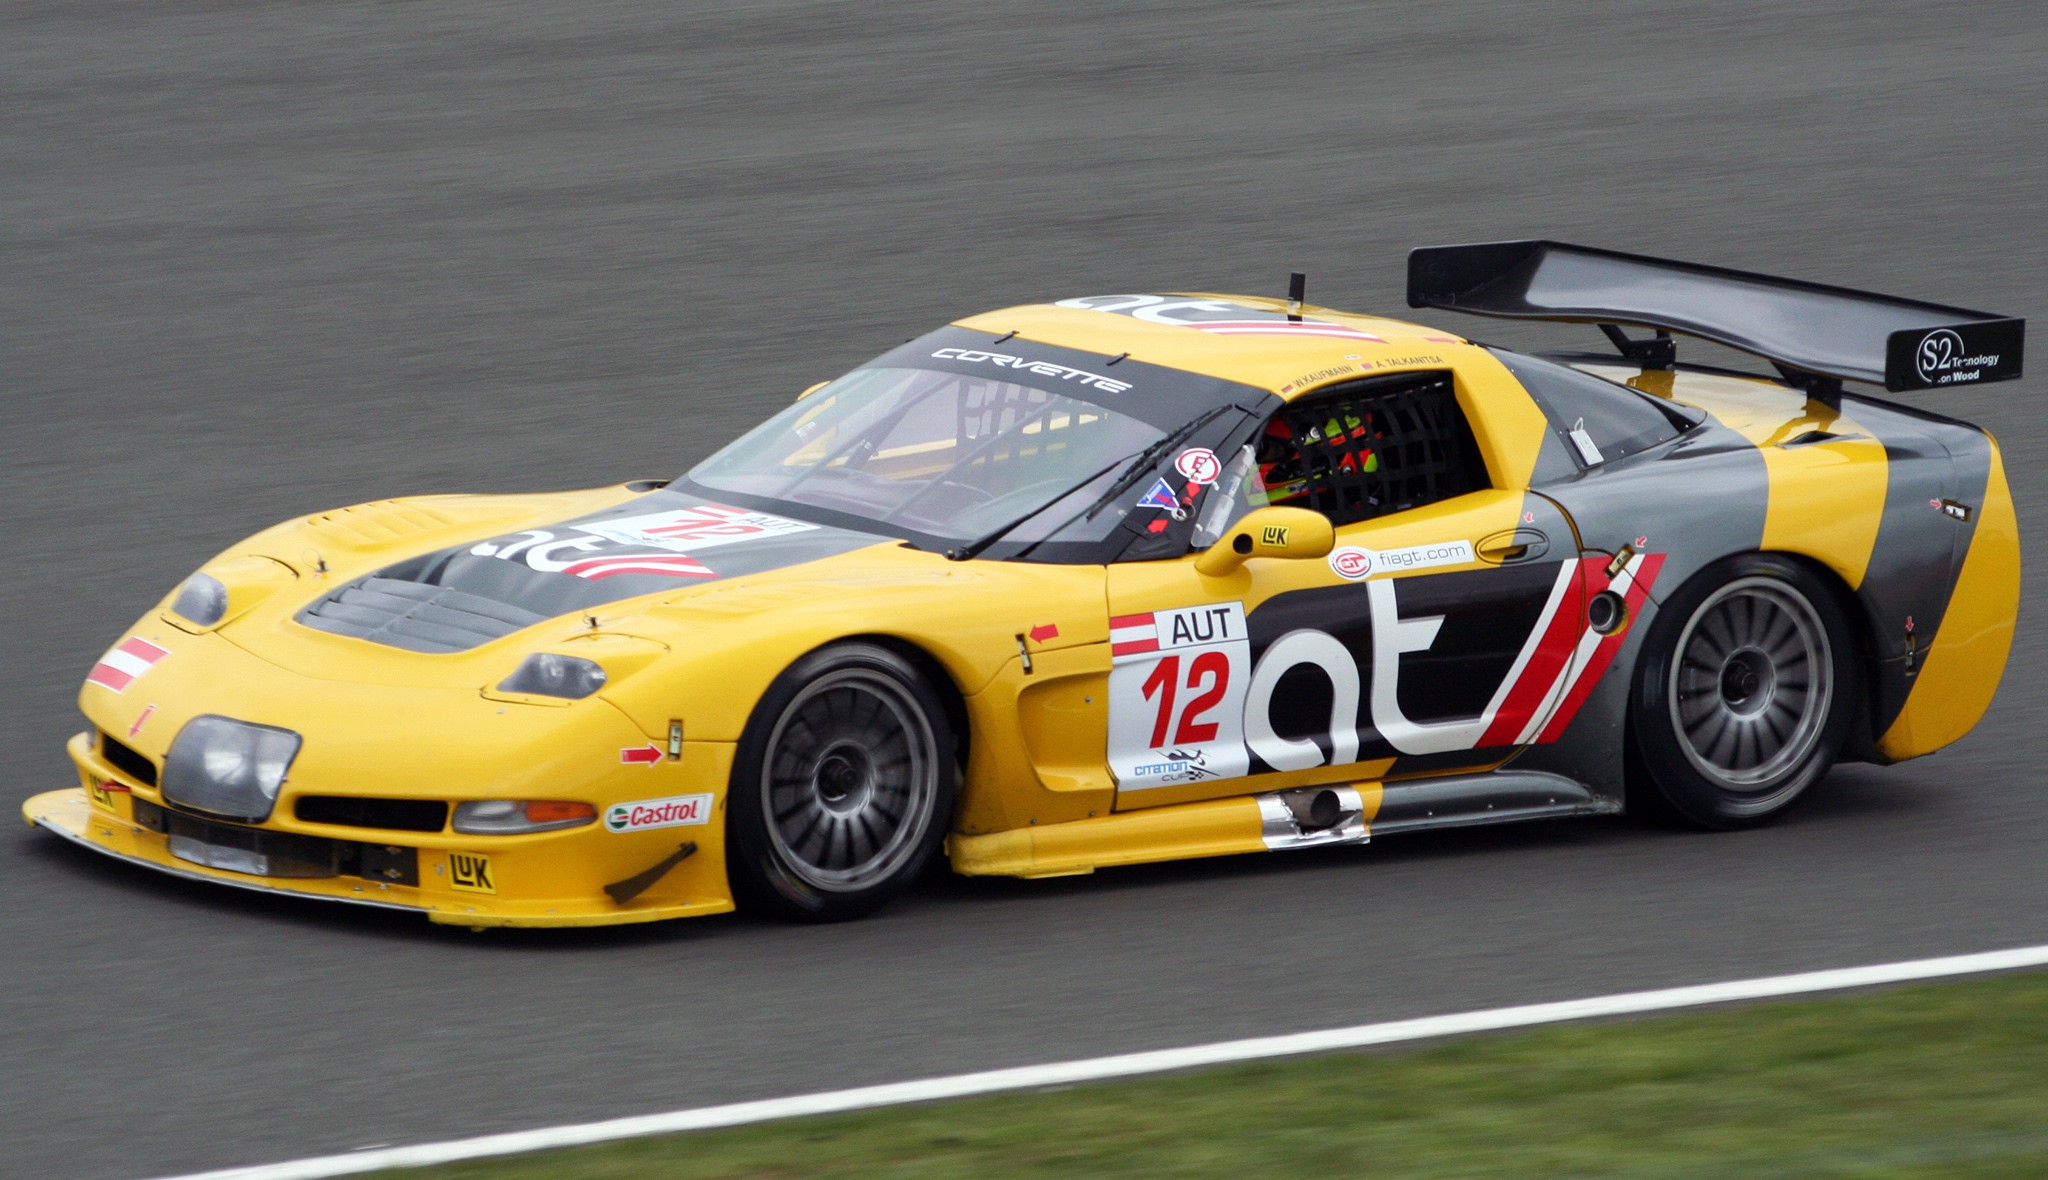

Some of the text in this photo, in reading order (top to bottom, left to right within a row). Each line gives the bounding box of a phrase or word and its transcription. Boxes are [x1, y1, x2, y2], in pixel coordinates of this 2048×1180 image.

[931, 348, 1133, 393] CORVETTE
[1923, 337, 1952, 371] S2
[1952, 369, 1980, 381] Wood
[1379, 545, 1467, 567] fiagt.com
[1172, 608, 1231, 645] AUT
[1141, 651, 1230, 749] 12
[631, 800, 698, 826] Castrol
